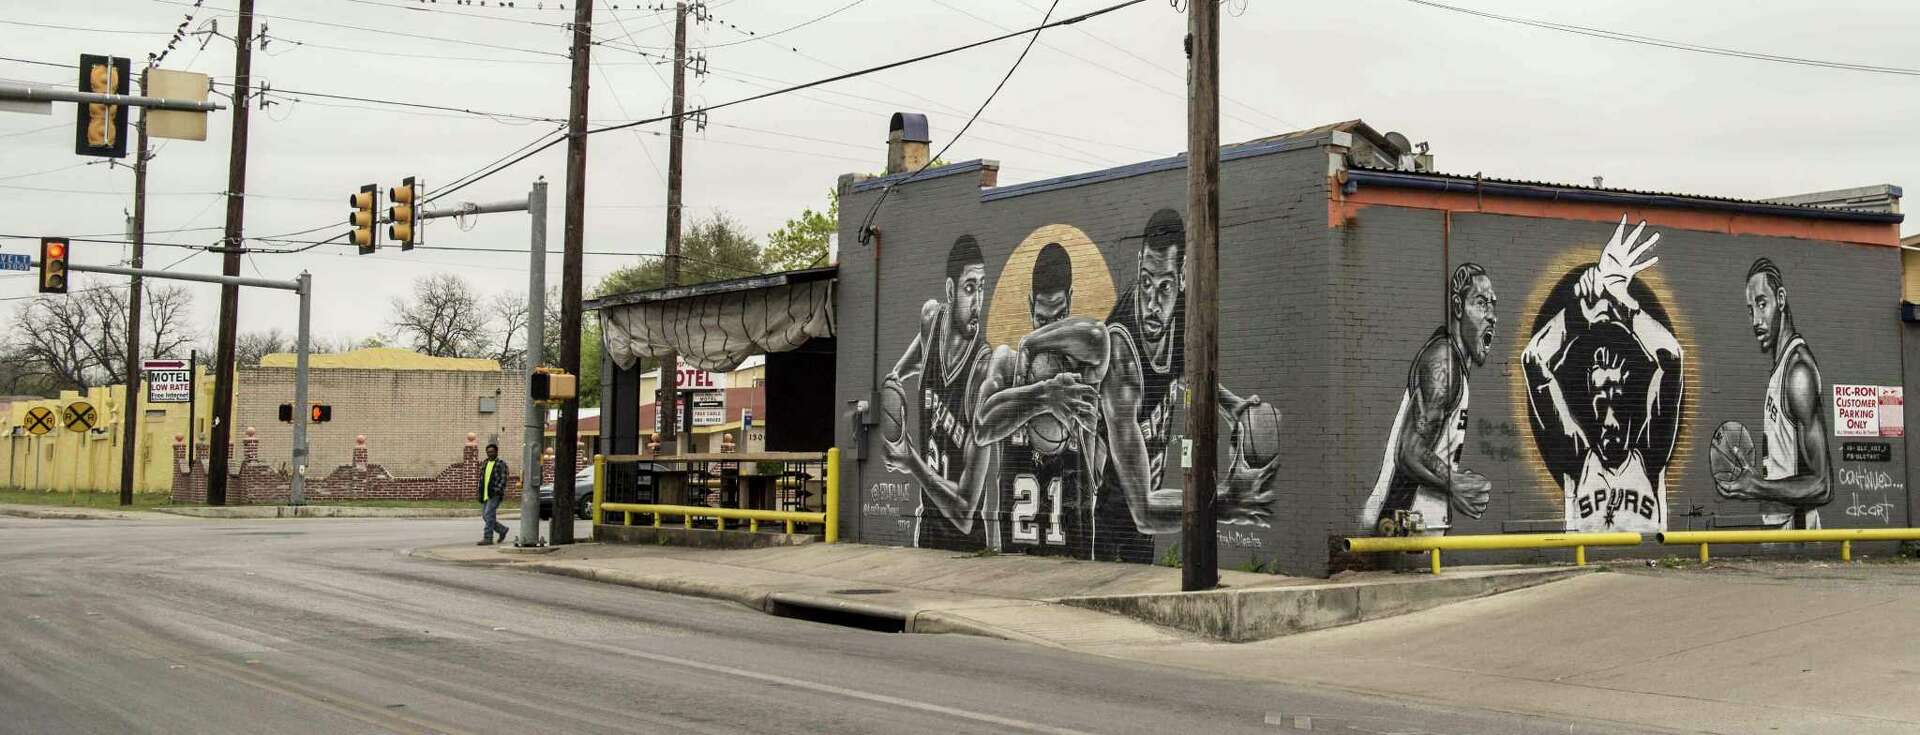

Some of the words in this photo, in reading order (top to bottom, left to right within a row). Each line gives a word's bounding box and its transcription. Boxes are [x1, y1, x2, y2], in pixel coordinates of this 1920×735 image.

[151, 372, 189, 382] MOTEL
[675, 369, 713, 387] OTEL
[1835, 387, 1876, 397] RIC-RON
[1836, 397, 1877, 408] CUSTOMER
[1839, 408, 1874, 419] PARKING
[1847, 419, 1867, 429] ONLY
[1011, 473, 1066, 545] 21
[1578, 488, 1656, 526] SPURS
